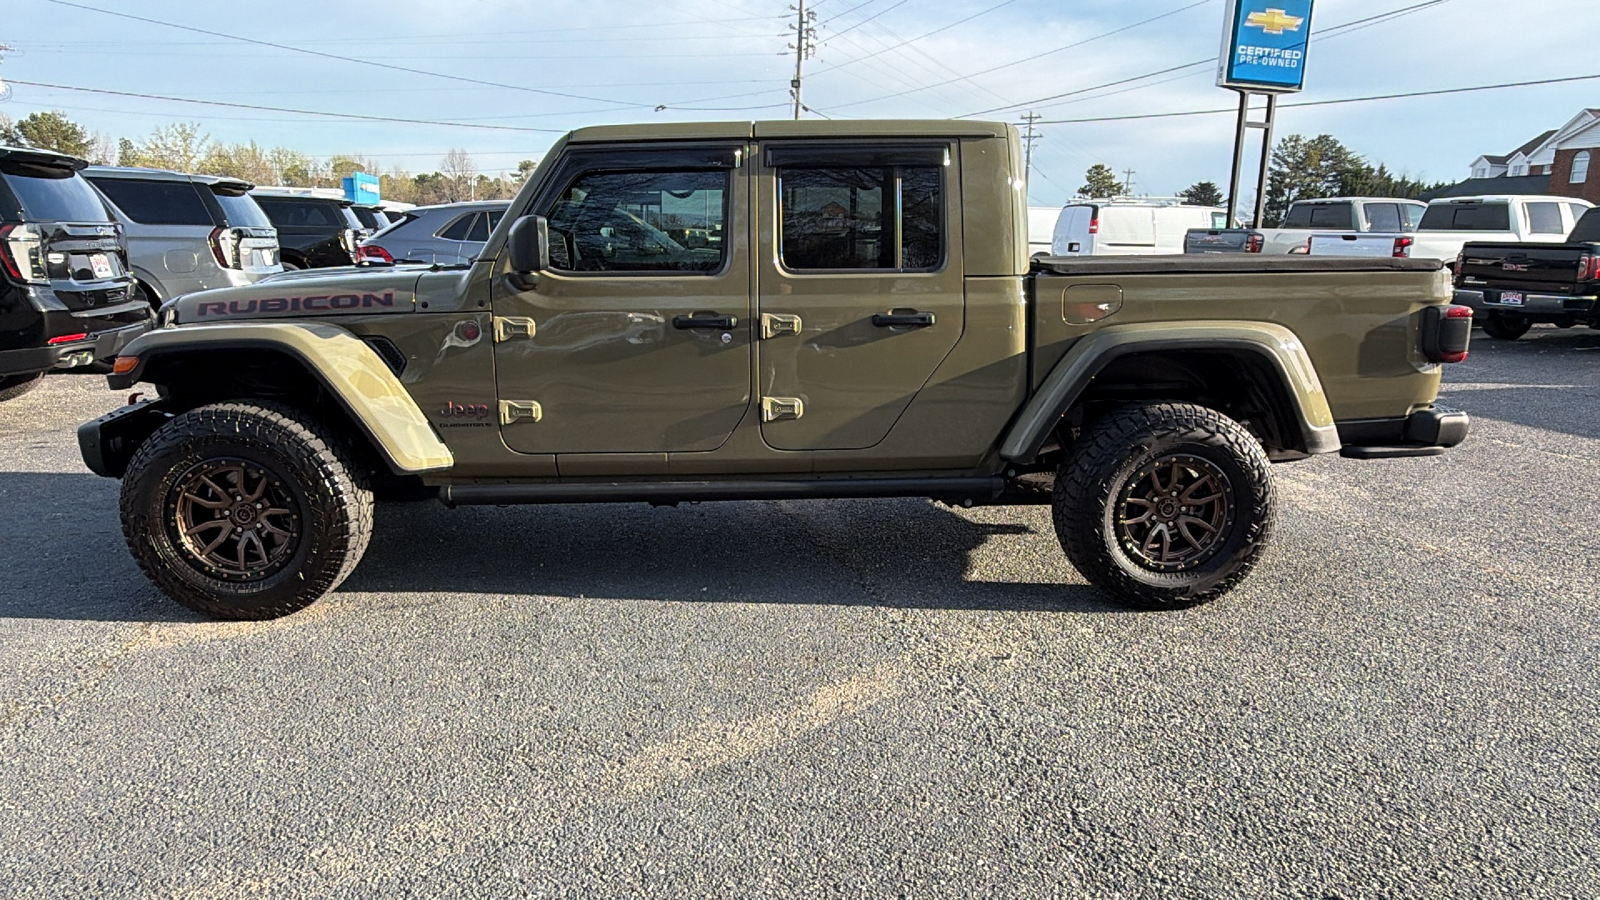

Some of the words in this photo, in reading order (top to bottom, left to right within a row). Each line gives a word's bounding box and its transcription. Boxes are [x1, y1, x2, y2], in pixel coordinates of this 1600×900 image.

[1237, 45, 1302, 59] CERTIFIED
[1239, 54, 1298, 68] PRE-OWNED
[197, 292, 395, 316] RUBICON
[439, 400, 489, 420] Jeep
